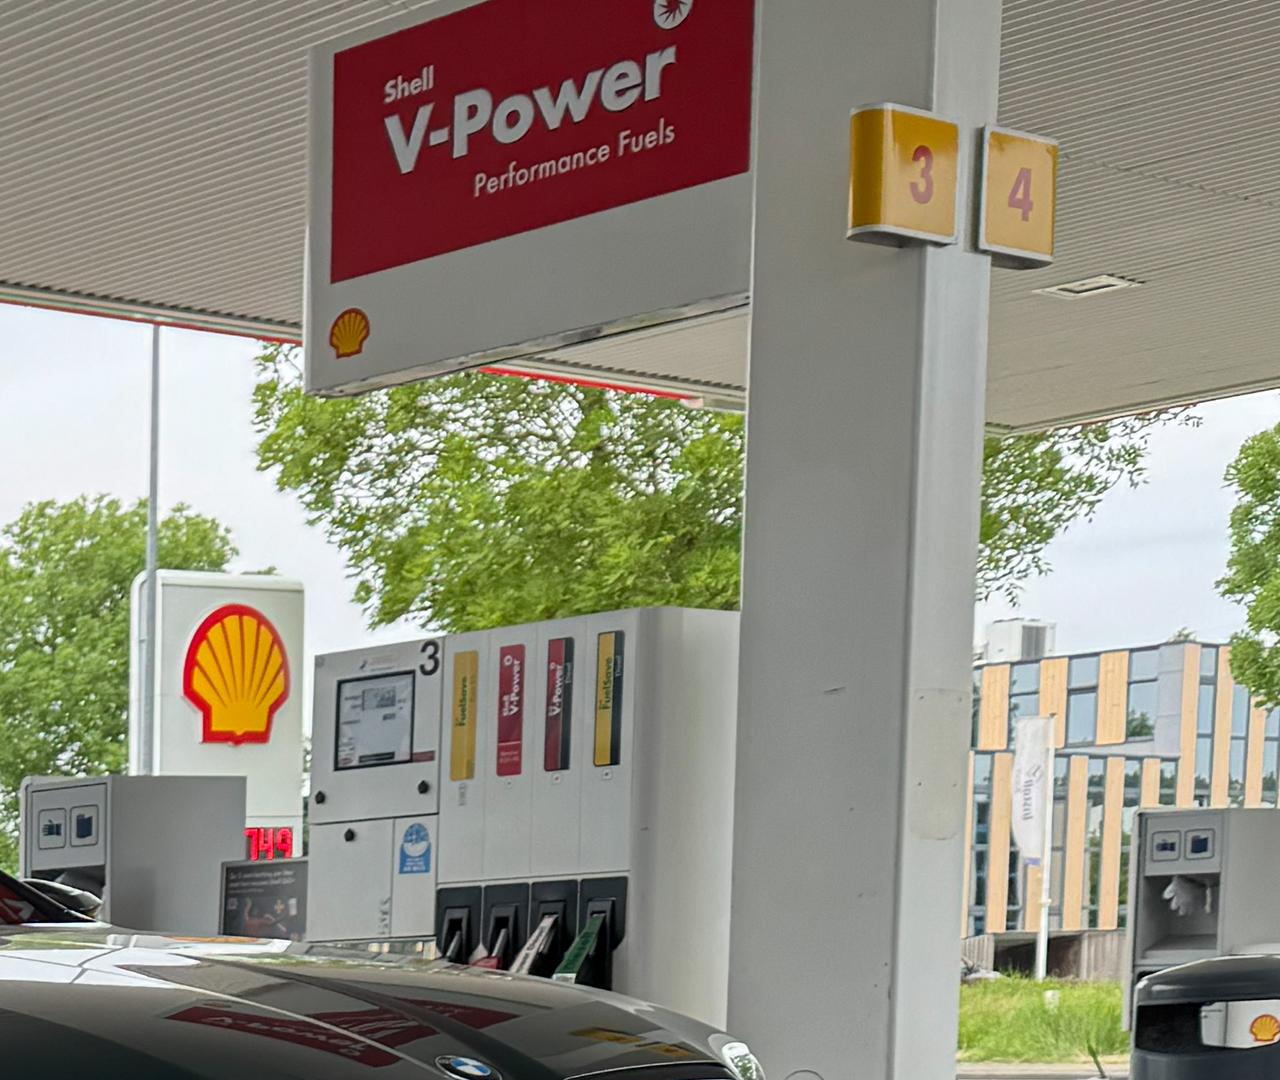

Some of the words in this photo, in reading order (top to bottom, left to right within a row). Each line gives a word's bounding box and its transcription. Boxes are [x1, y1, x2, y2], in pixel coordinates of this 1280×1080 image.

[383, 65, 435, 104] Shell
[383, 45, 677, 175] V-Power
[473, 143, 611, 198] Performance
[617, 117, 676, 157] Fuels
[909, 144, 934, 204] 3
[1007, 166, 1034, 222] 4
[419, 639, 440, 676] 3
[599, 657, 613, 711] FuelSave
[507, 659, 521, 716] V-Power
[551, 664, 563, 716] V-Power
